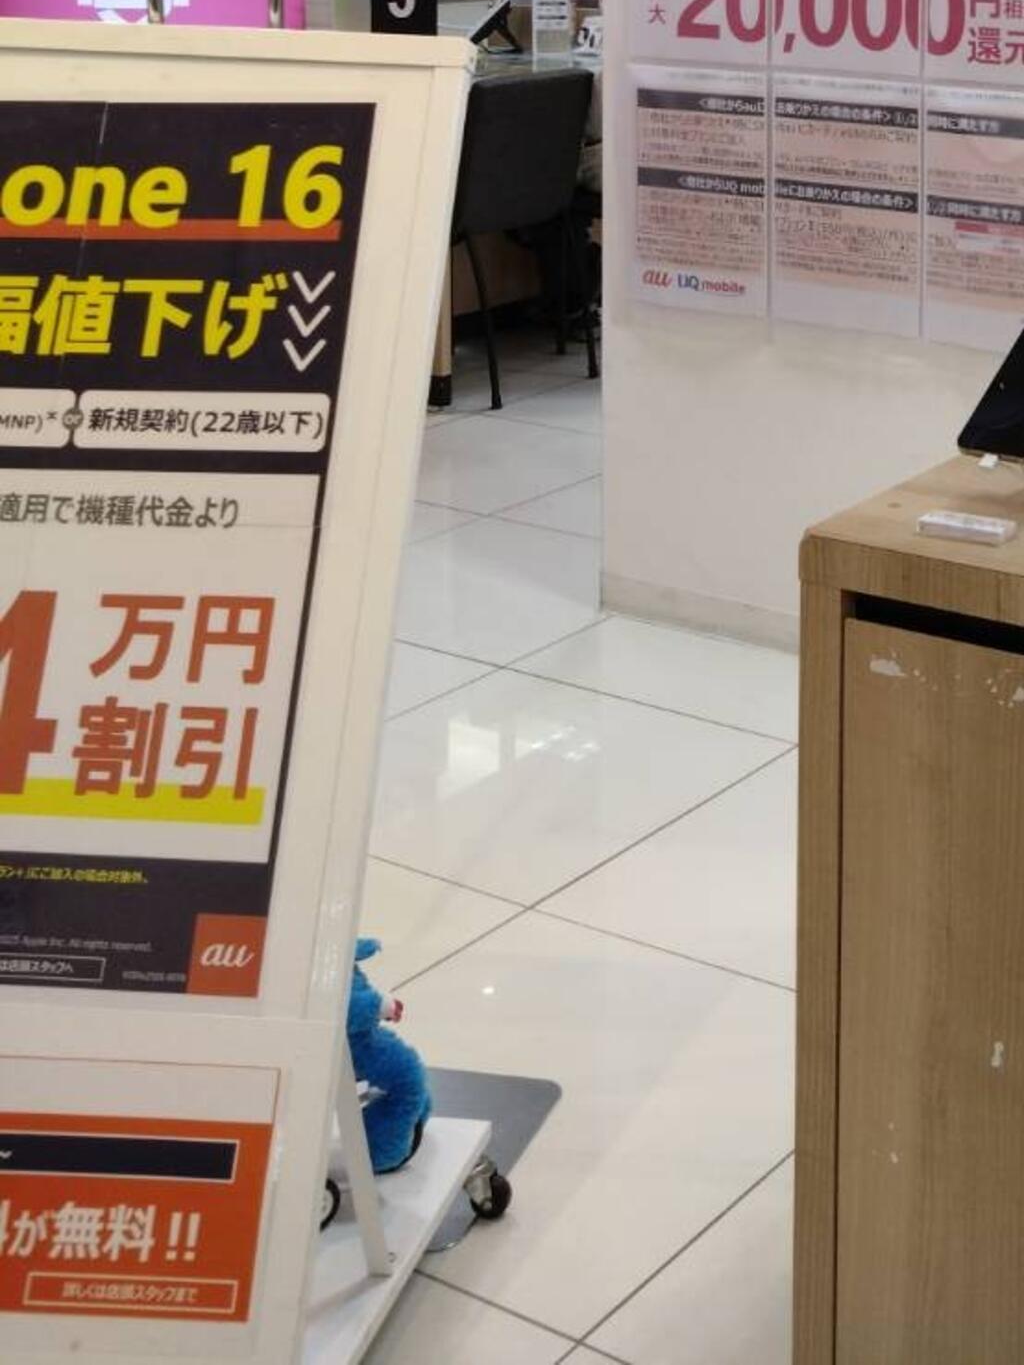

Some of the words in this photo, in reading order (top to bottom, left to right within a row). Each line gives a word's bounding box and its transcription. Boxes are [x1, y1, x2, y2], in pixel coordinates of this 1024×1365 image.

[229, 145, 344, 229] 16
[643, 270, 672, 285] au
[89, 409, 324, 439] 新規契約(22歳以下)
[89, 593, 276, 685] 万円
[71, 696, 258, 801] 割引
[201, 943, 255, 967] au
